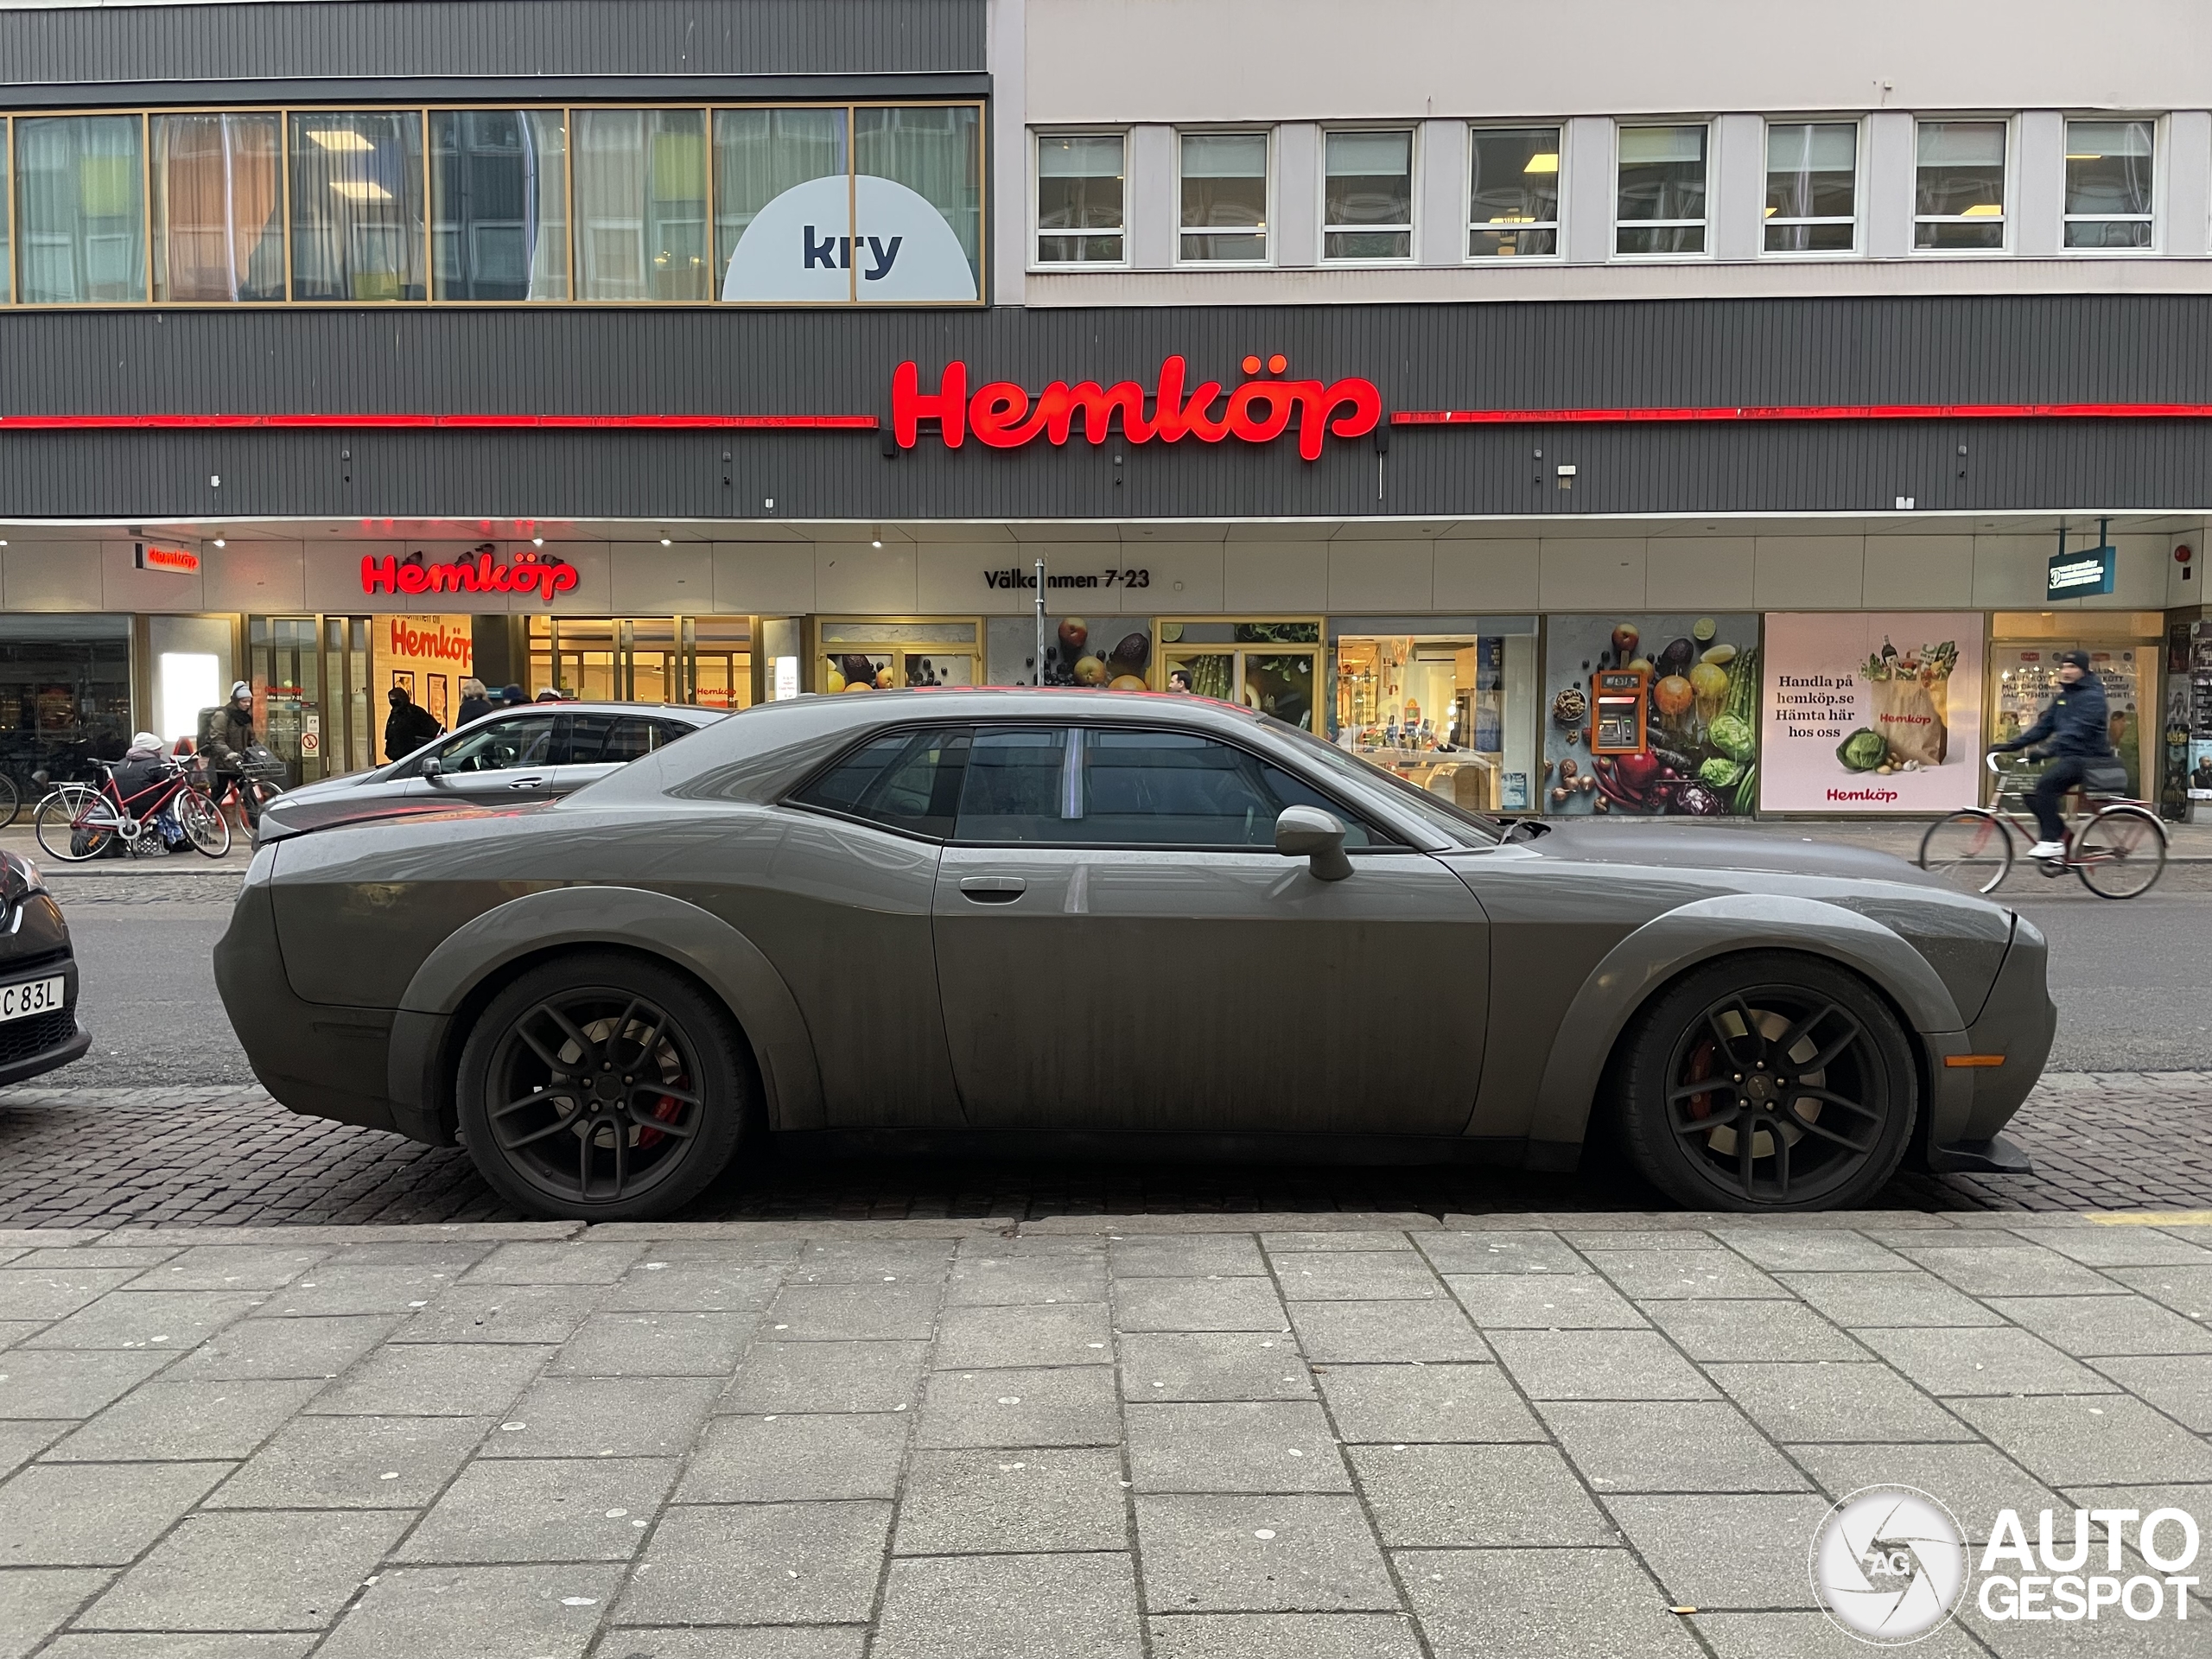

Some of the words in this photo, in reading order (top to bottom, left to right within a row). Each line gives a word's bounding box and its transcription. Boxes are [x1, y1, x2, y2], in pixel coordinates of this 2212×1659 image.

[804, 226, 903, 281] kry
[891, 354, 1382, 461] Hemköp
[147, 547, 200, 572] Hemköp
[361, 553, 577, 600] Hemköp
[1104, 569, 1150, 588] 7-23
[1778, 675, 1833, 687] Handla
[1835, 674, 1853, 690] på
[1777, 692, 1854, 706] hemköp.se
[1776, 709, 1826, 721] Hämta
[1828, 709, 1855, 721] här
[1879, 713, 1931, 725] Hemköp
[1789, 726, 1814, 737] hos
[1816, 728, 1840, 737] oss
[1827, 787, 1898, 803] Hemköp
[0, 989, 15, 1015] C
[21, 982, 55, 1011] 83L
